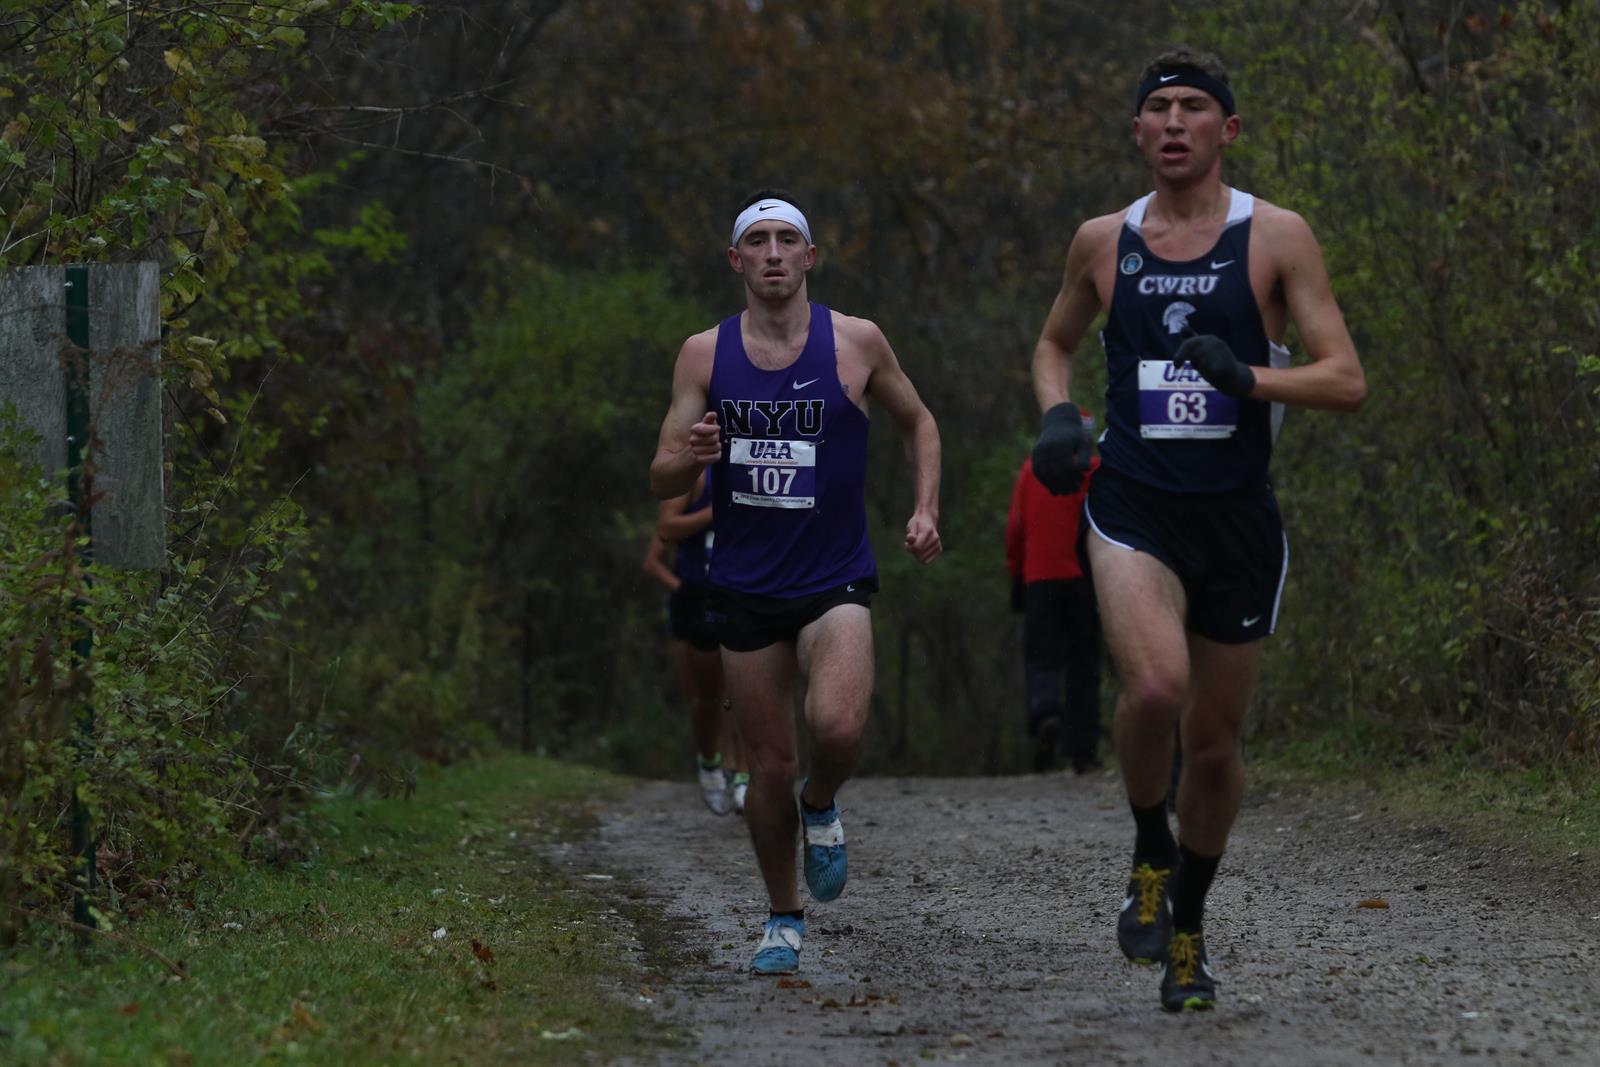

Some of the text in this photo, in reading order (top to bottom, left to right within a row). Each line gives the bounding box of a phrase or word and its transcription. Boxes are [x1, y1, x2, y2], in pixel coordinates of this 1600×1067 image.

[1138, 274, 1220, 295] CWRU
[1163, 362, 1206, 383] UA
[721, 400, 825, 436] NYU
[1167, 392, 1208, 424] 63
[749, 441, 794, 460] UAA
[747, 467, 797, 495] 107
